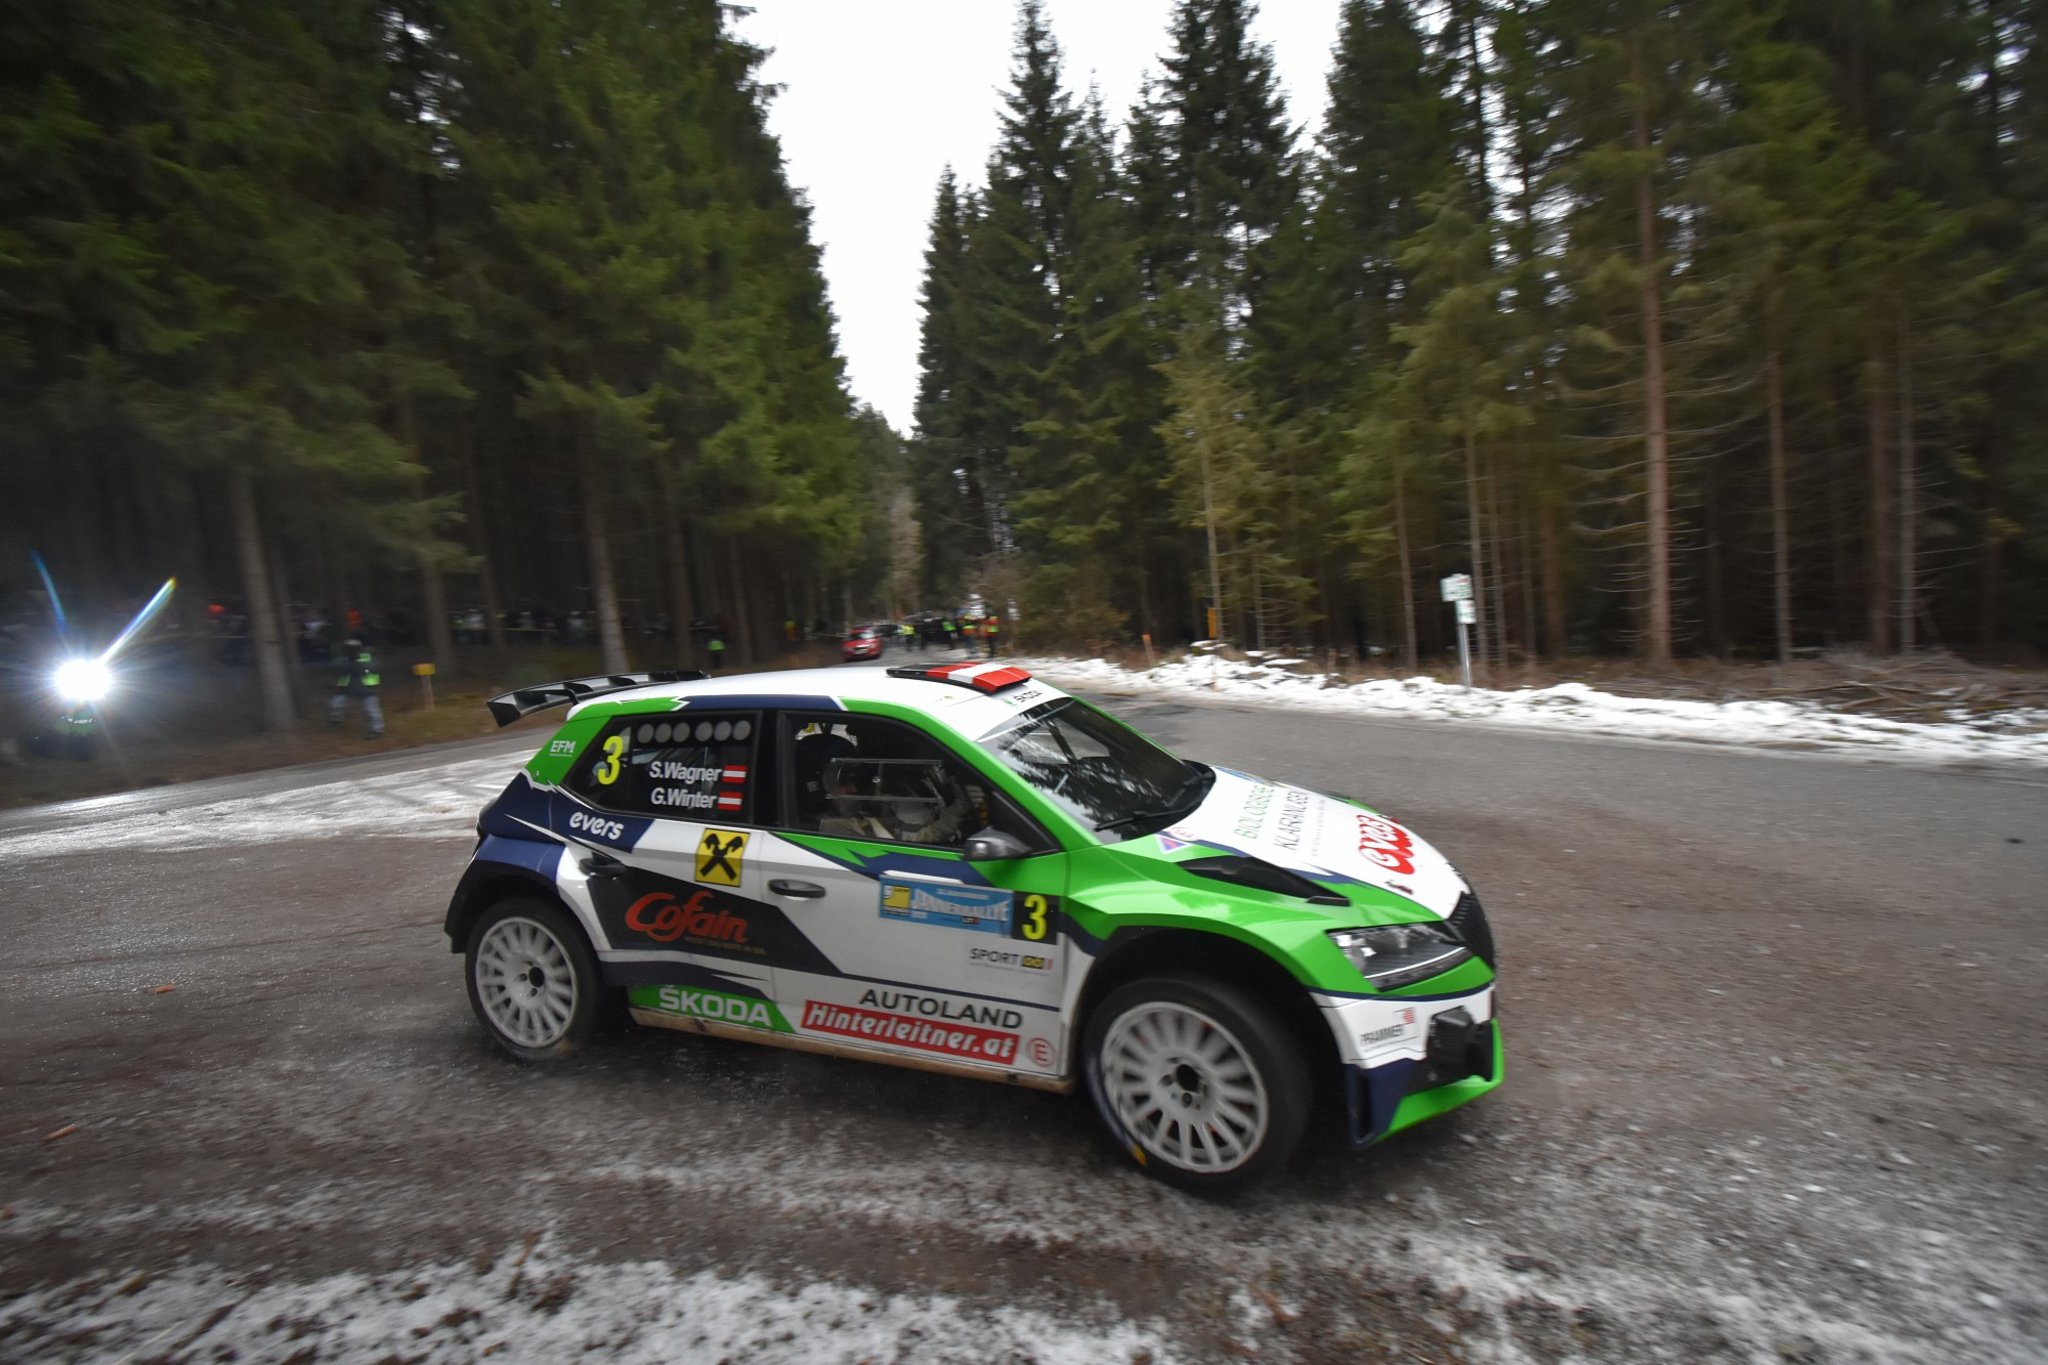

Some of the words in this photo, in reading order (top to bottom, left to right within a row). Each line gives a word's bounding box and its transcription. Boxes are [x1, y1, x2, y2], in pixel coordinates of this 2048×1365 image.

[550, 740, 577, 753] EFM
[599, 735, 624, 786] 3
[649, 761, 722, 784] S.Wagner
[651, 787, 717, 809] G.Winter
[569, 811, 624, 840] evers
[625, 890, 748, 942] Cofain
[1021, 894, 1048, 940] 3
[969, 948, 1019, 966] SPORT
[658, 984, 773, 1027] ŠKODA
[859, 989, 1022, 1029] AUTOLAND
[806, 1003, 1016, 1058] Hinterleitner.at
